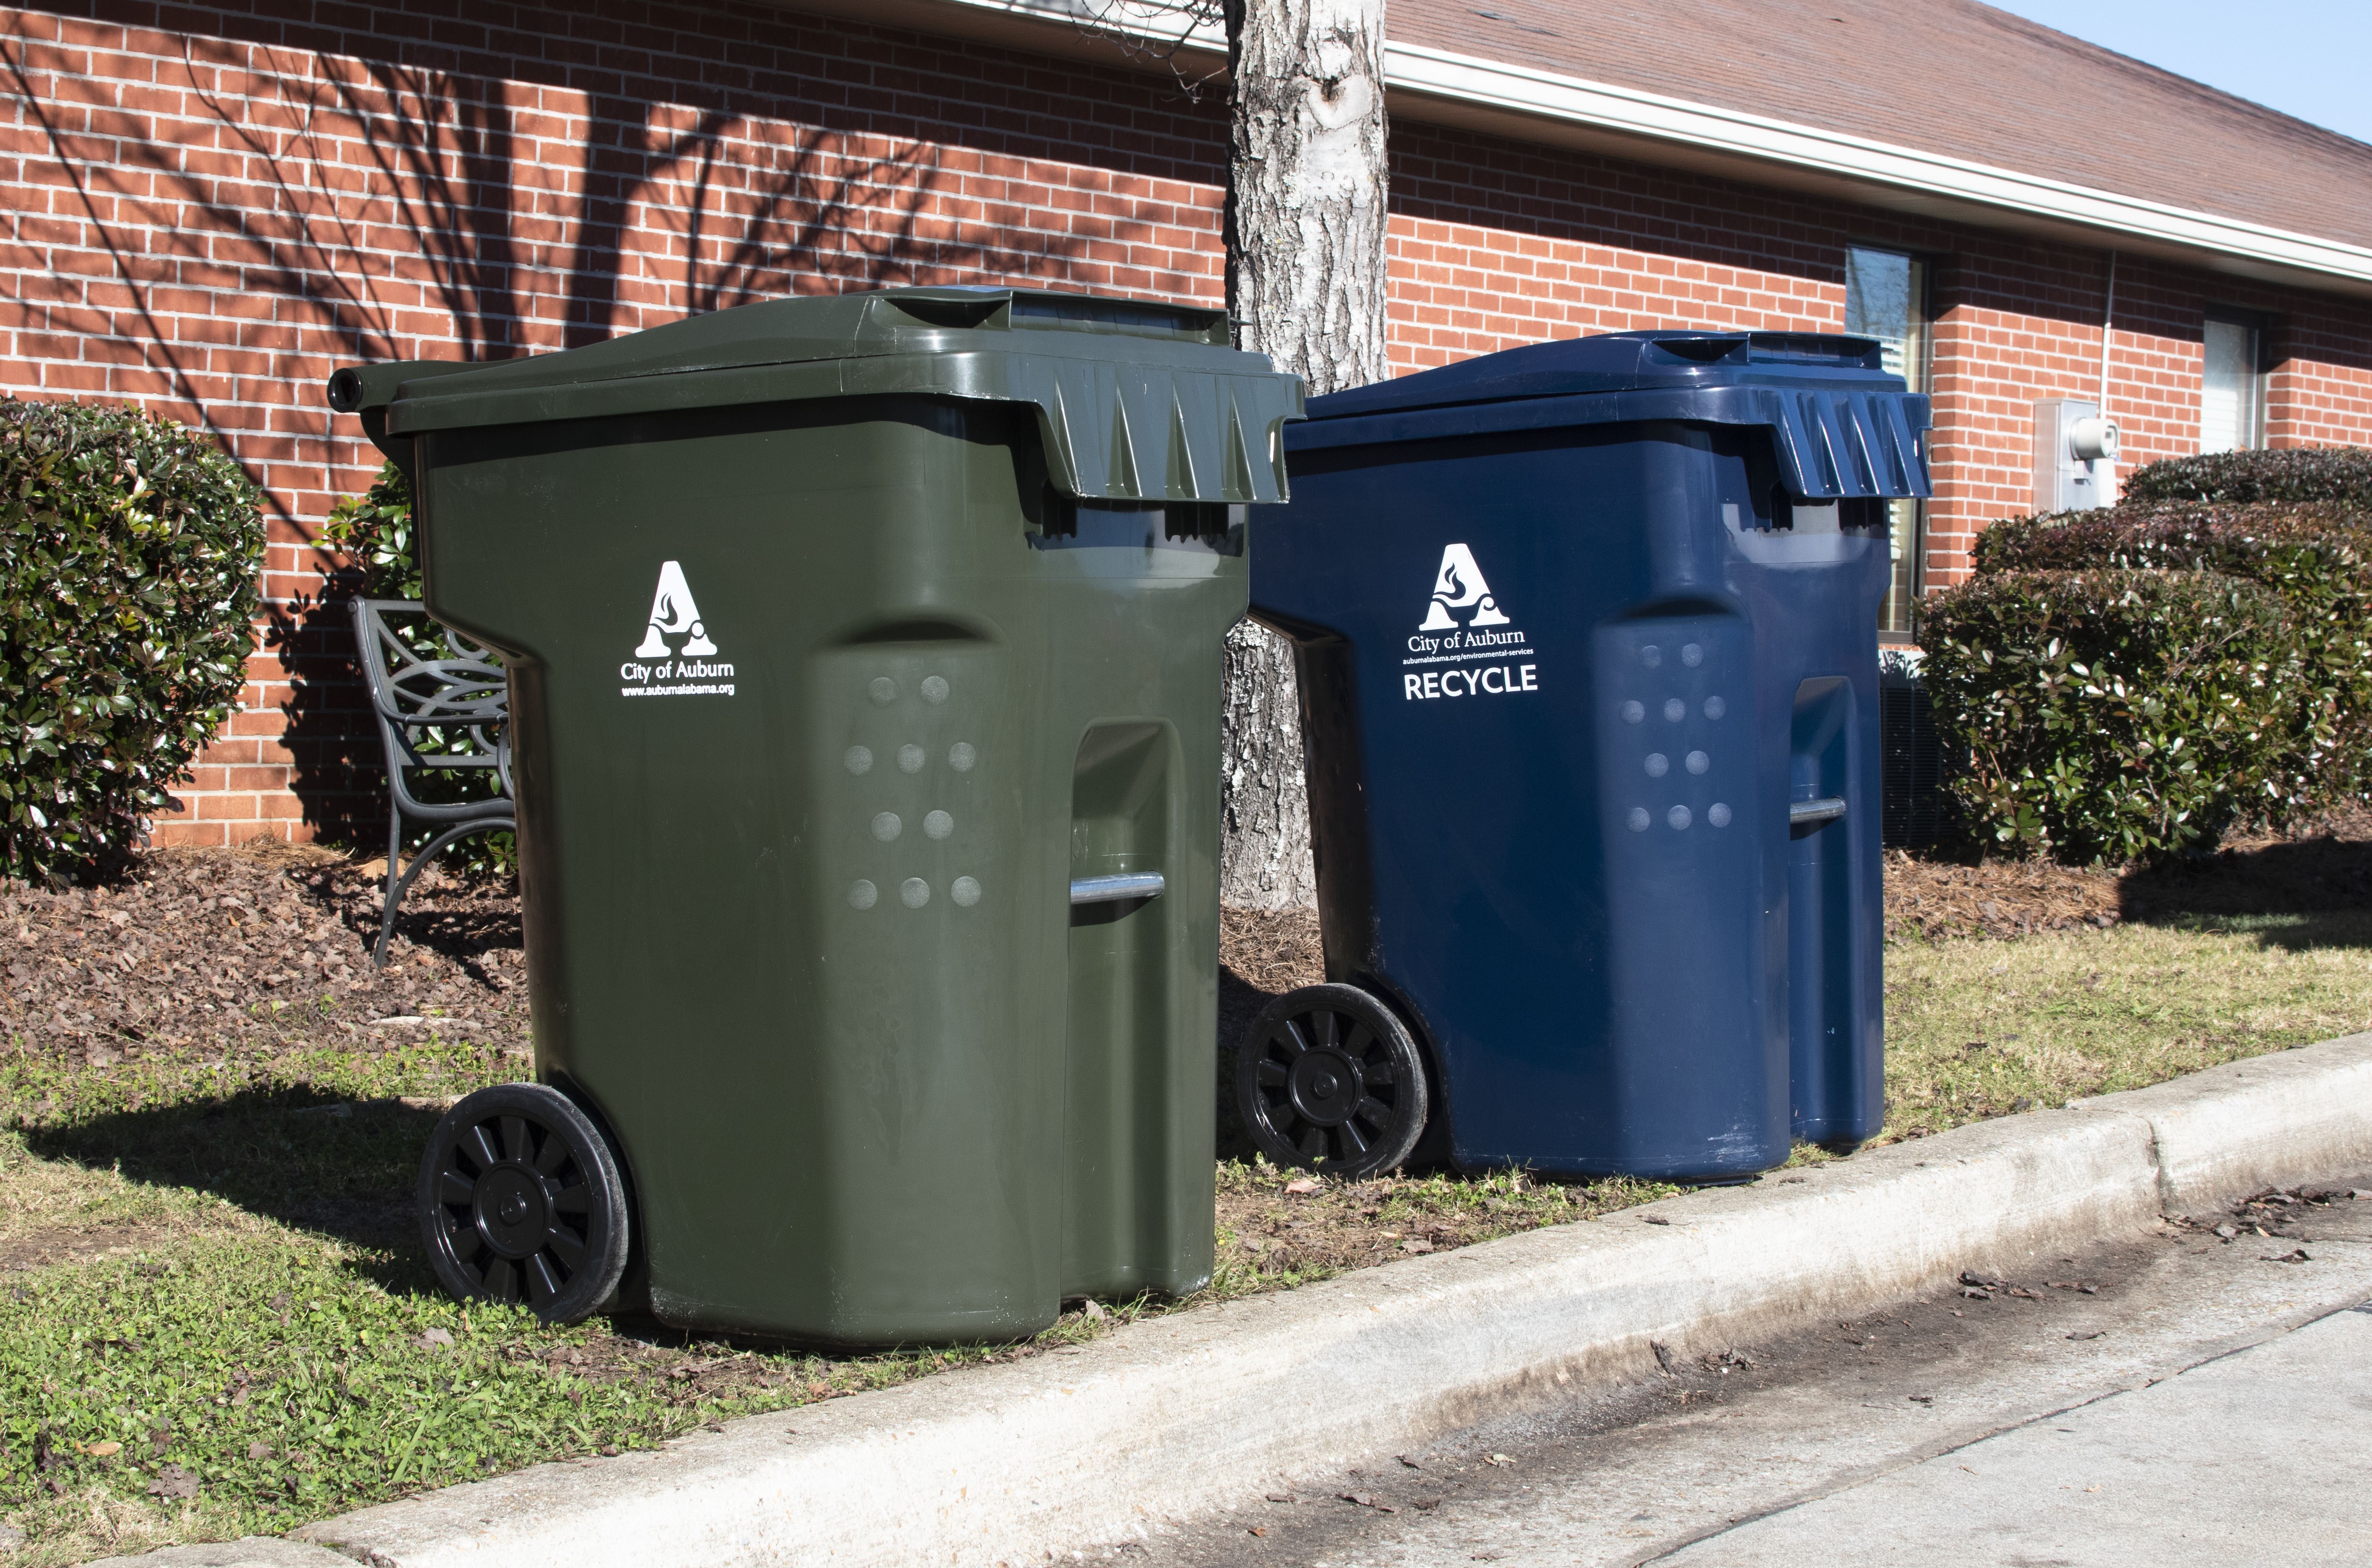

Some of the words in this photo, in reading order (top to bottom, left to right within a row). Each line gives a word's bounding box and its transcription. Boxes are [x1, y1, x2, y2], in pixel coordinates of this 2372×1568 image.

[1408, 635, 1440, 654] City
[1444, 631, 1461, 649] of
[1464, 629, 1526, 647] Auburn
[1403, 648, 1534, 665] auburnalabama.org/environmental-services
[621, 663, 652, 684] City
[655, 660, 673, 678] of
[675, 659, 734, 678] Auburn
[1404, 664, 1538, 700] RECYCLE
[621, 683, 735, 697] www.auburnalabama.org
